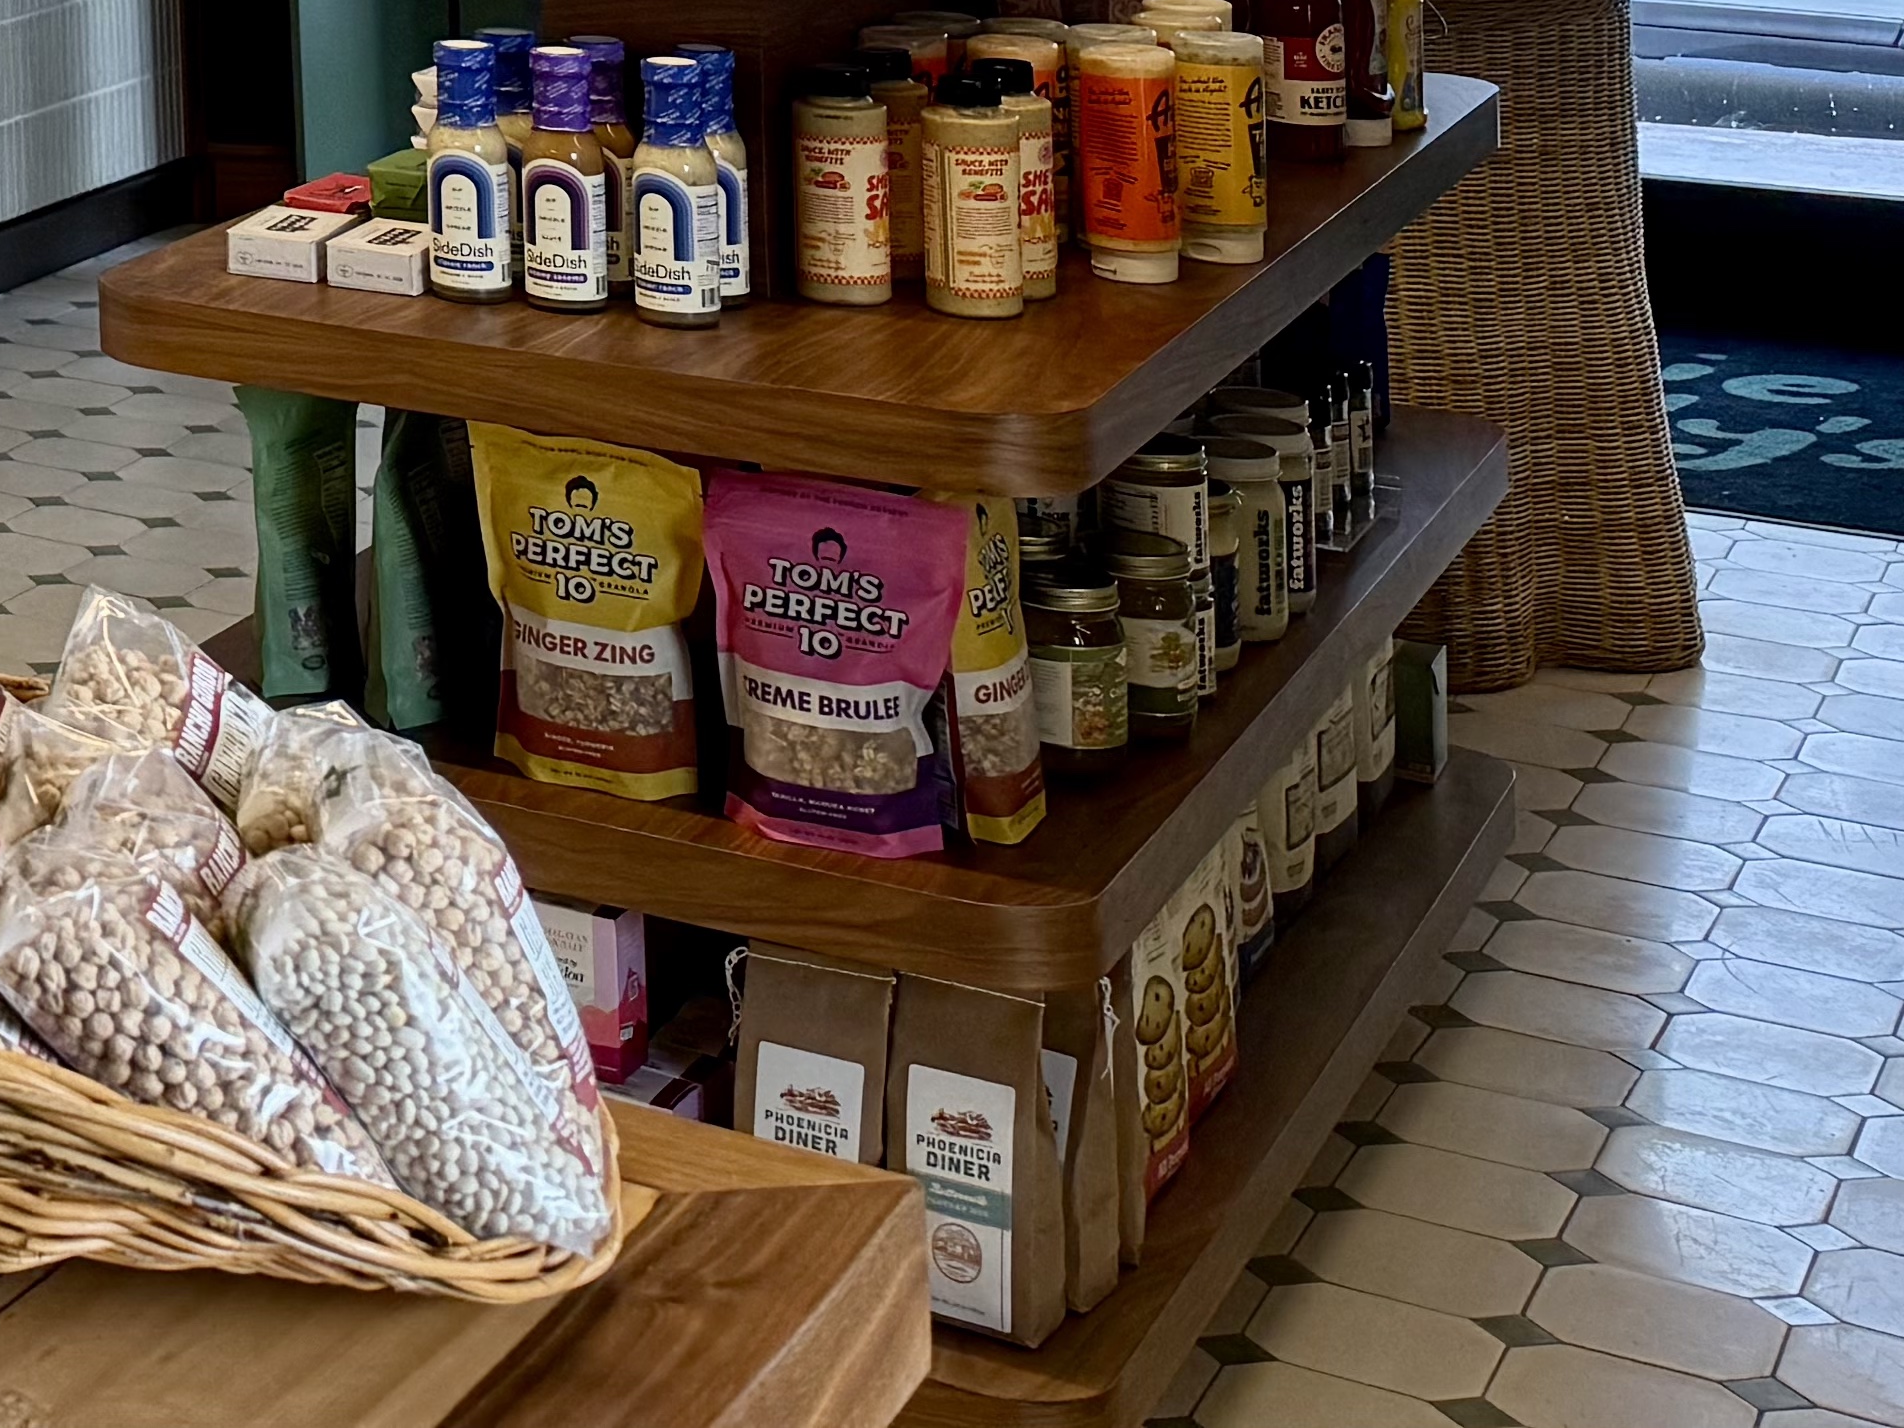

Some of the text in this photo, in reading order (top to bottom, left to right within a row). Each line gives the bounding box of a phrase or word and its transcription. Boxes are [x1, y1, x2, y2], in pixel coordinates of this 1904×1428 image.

[1300, 95, 1345, 110] KETC
[528, 506, 635, 559] TOM'S
[1288, 484, 1304, 591] fatworks
[510, 532, 658, 584] PERFECT
[1254, 508, 1271, 618] fatworks
[555, 571, 597, 604] 10
[598, 581, 649, 596] GRANOLA
[768, 557, 883, 603] TOM'S
[743, 583, 909, 639] PERFECT
[513, 620, 656, 665] GINGER ZING
[797, 626, 842, 658] 10
[175, 653, 221, 769] RANCHO GORDO
[764, 1108, 850, 1142] PHOENICIA
[774, 1124, 839, 1158] DINER
[915, 1133, 1003, 1167] PHOENICIA
[925, 1150, 992, 1184] DINER
